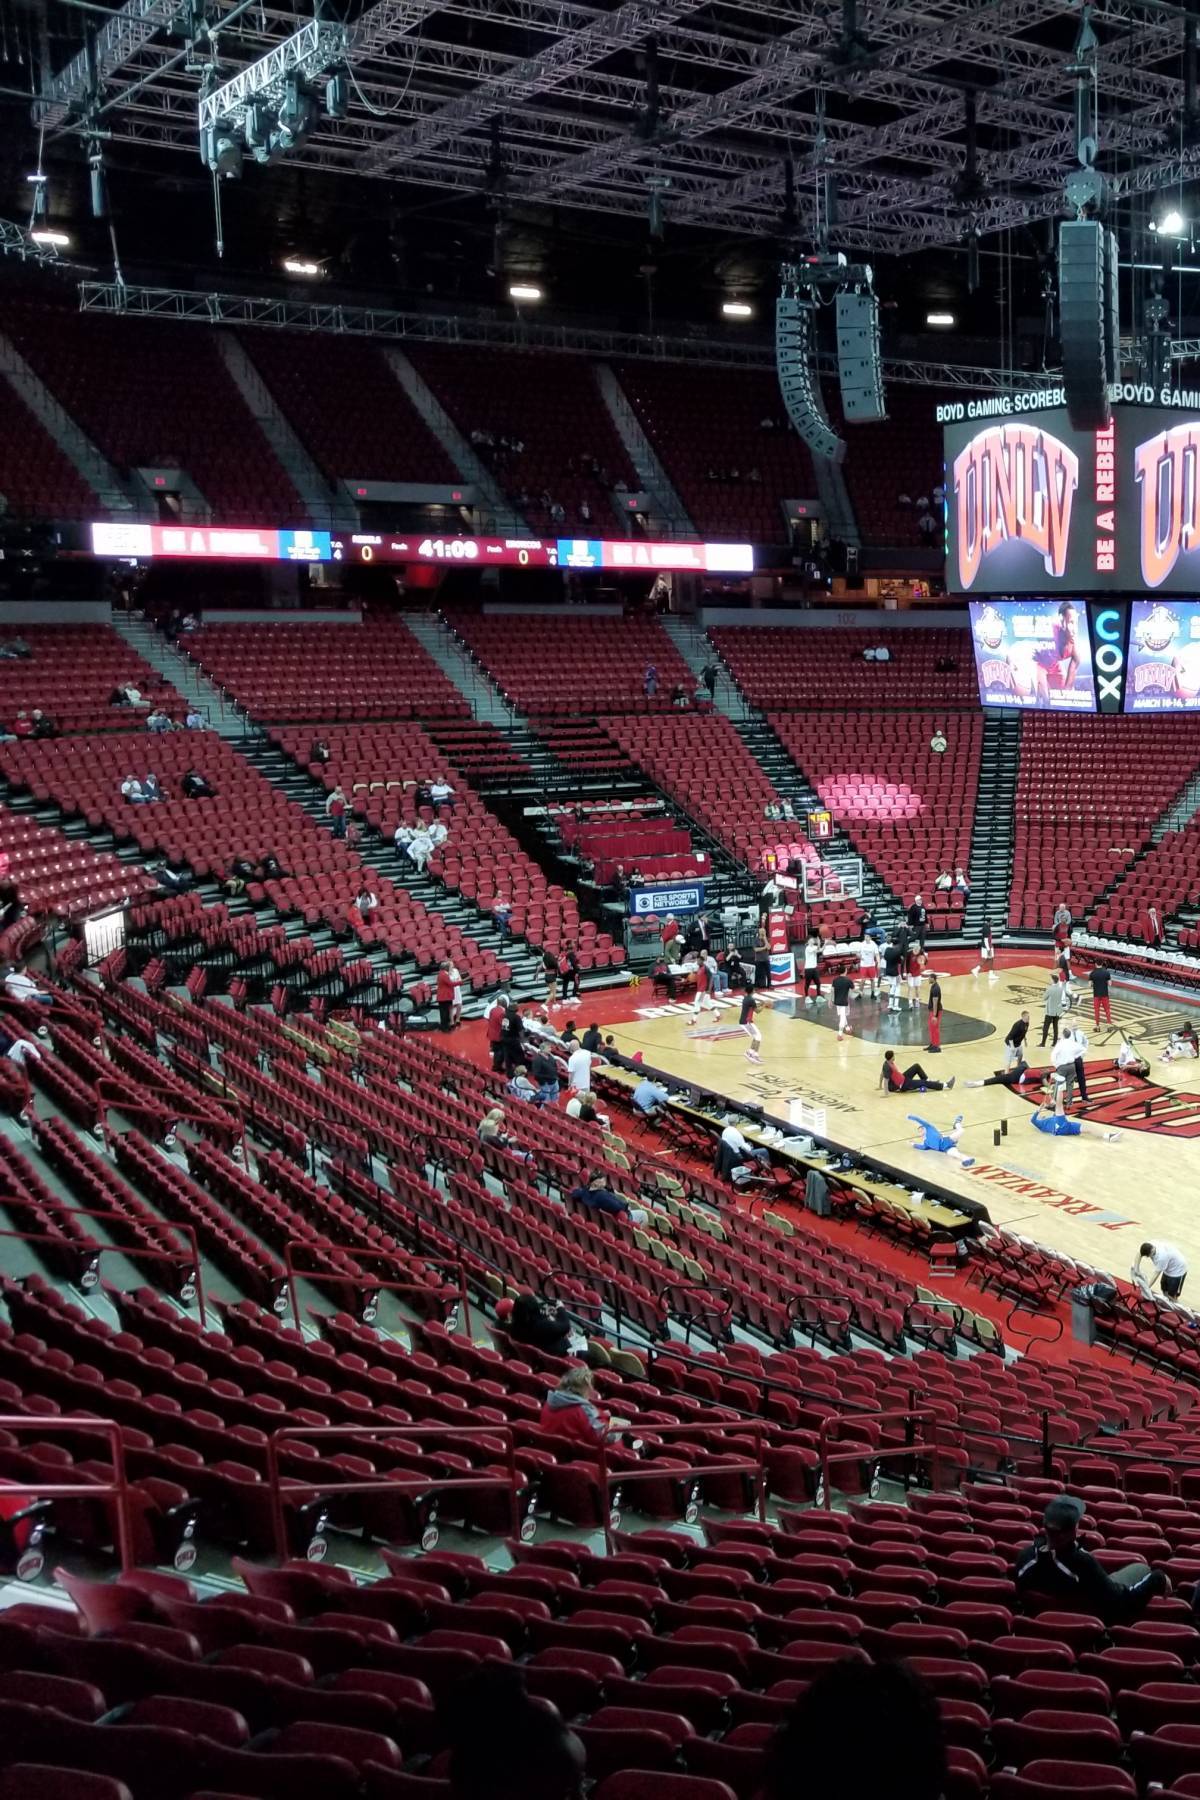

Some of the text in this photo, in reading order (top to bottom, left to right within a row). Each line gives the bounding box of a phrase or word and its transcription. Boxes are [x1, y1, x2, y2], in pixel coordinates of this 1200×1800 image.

[1113, 383, 1154, 403] BOYD
[937, 403, 964, 421] BOYD
[968, 397, 1011, 418] GAMING
[953, 422, 1079, 589] UNLV
[1097, 511, 1114, 532] A
[361, 545, 373, 561] 0
[418, 539, 478, 558] 41:09
[519, 549, 528, 565] 0
[1097, 540, 1114, 570] BE
[1096, 610, 1122, 699] COX
[653, 892, 696, 902] CBS SPORTS
[653, 899, 690, 908] NETWORK
[789, 1086, 864, 1112] AMERICA
